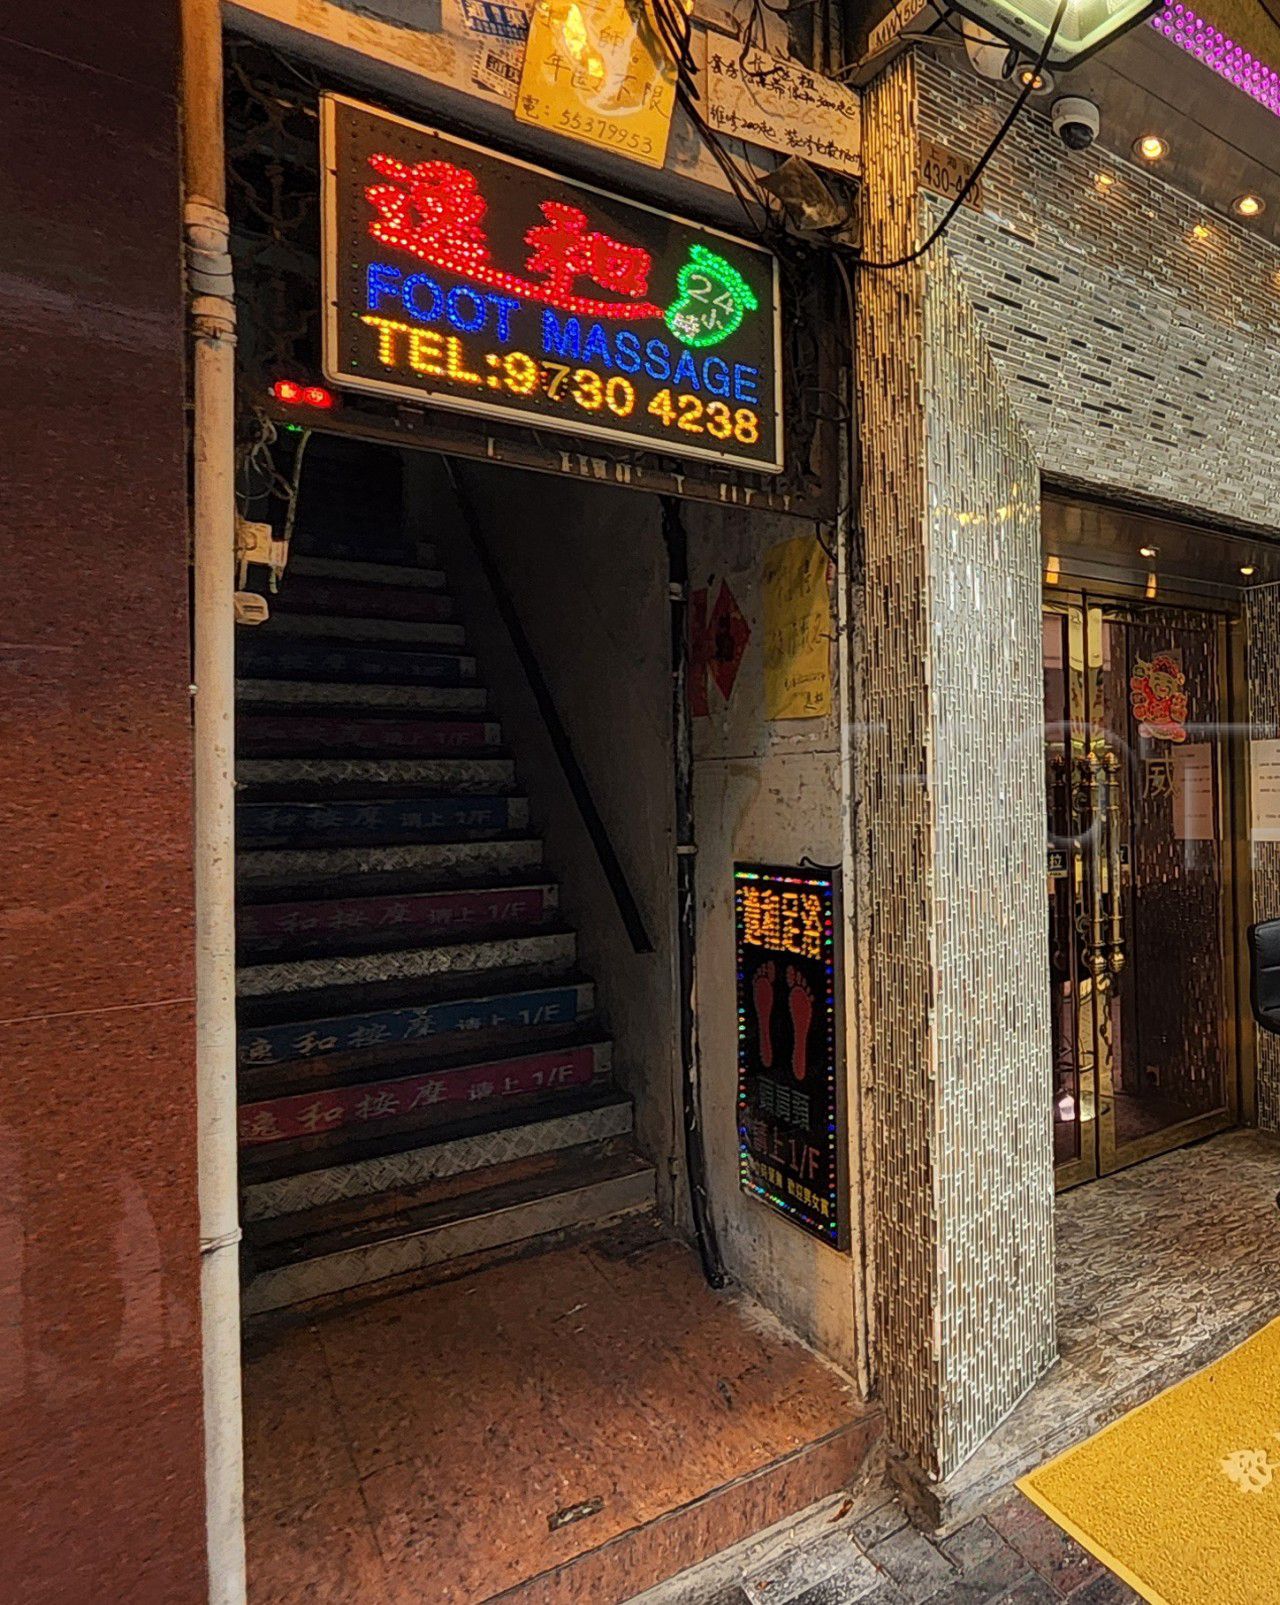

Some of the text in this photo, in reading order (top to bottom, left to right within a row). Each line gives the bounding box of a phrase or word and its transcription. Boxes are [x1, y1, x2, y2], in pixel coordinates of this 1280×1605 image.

[923, 158, 981, 208] 430-42
[366, 261, 760, 404] FOOT MASSAGE
[647, 388, 760, 446] 4238
